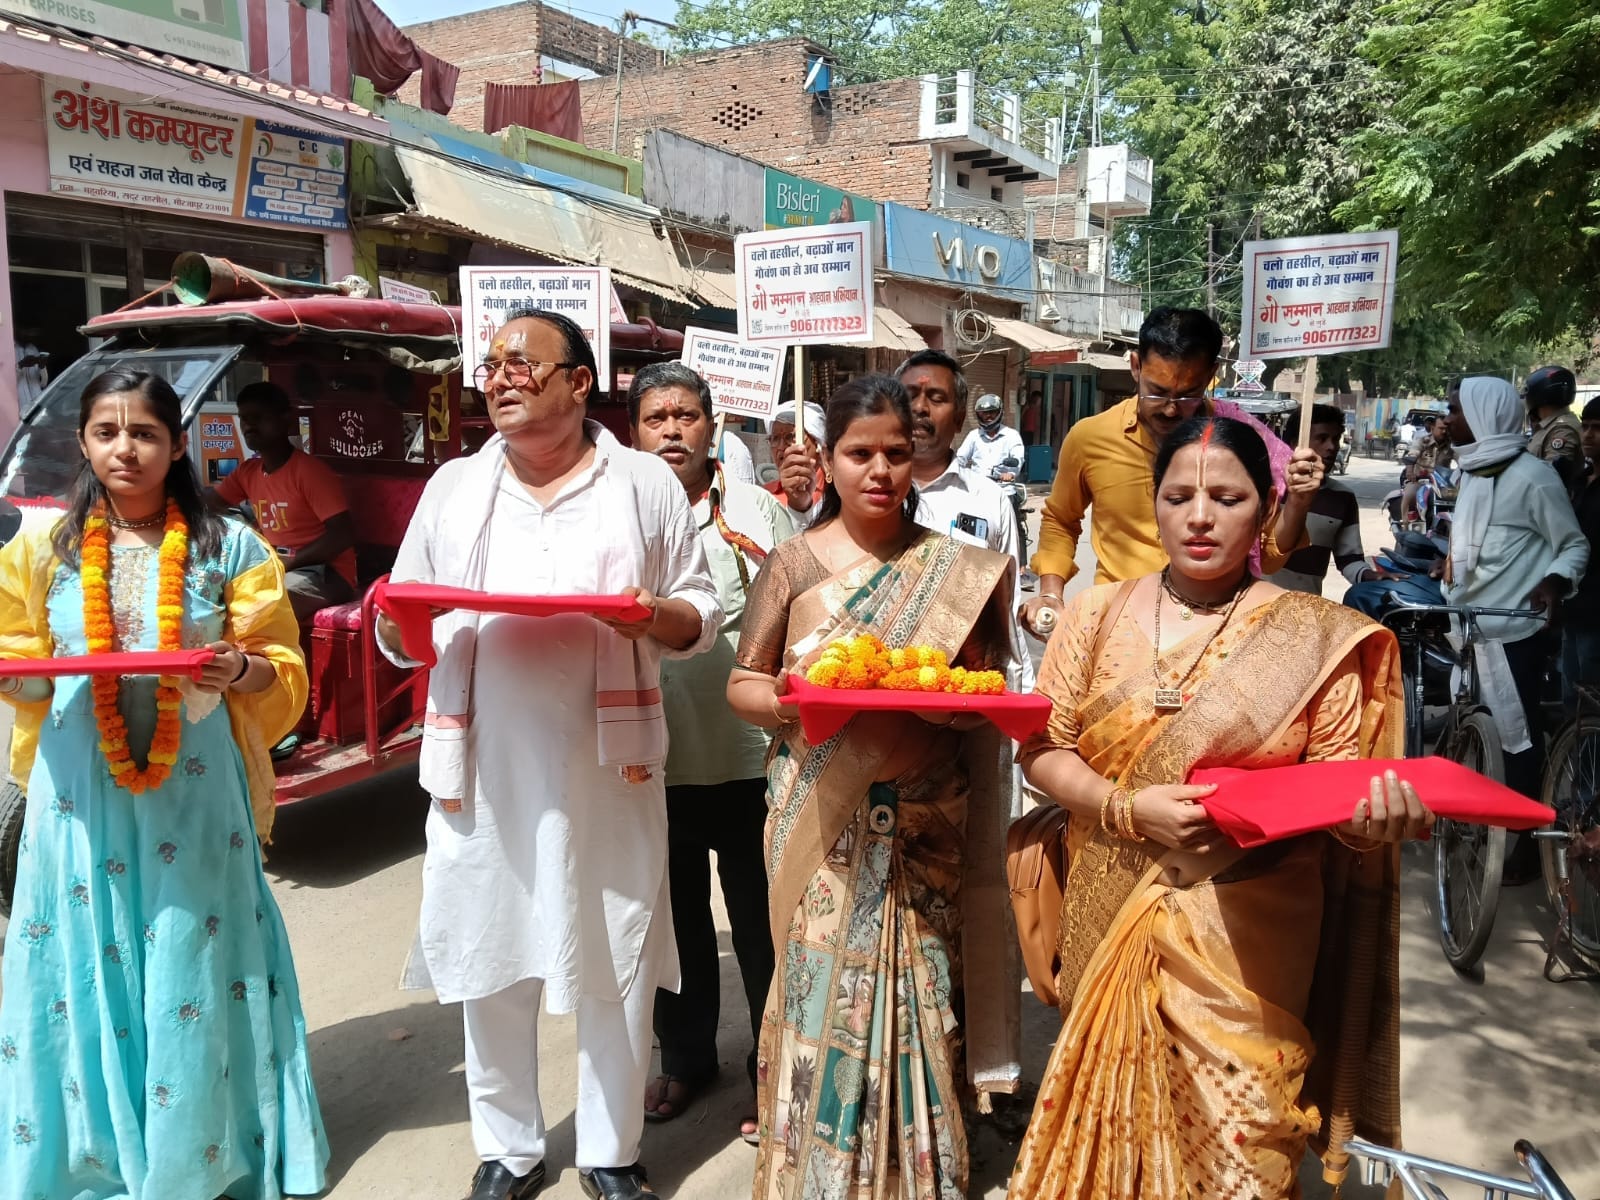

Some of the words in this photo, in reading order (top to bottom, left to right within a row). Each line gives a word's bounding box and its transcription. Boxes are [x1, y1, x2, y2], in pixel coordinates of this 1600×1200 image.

[54, 81, 121, 138] अंश
[125, 109, 235, 162] कम्प्यूटर
[69, 153, 93, 174] एवं
[96, 160, 135, 178] सहज
[138, 166, 164, 182] जन
[167, 167, 194, 186] सेवा
[197, 172, 228, 192] केन्द्र
[777, 183, 820, 212] Bisleri
[752, 247, 768, 261] चलो
[769, 244, 803, 259] तहसील,
[836, 241, 854, 254] मान
[779, 265, 791, 277] का
[793, 262, 802, 276] हो
[803, 263, 819, 275] अब
[821, 260, 851, 273] सम्मान
[1263, 256, 1284, 271] चलो
[1286, 254, 1325, 270] तहसील,
[1361, 251, 1379, 263] मान
[478, 276, 497, 290] चलो
[500, 276, 535, 292] तहसील,
[571, 279, 592, 291] मान
[1296, 276, 1309, 287] का
[1311, 272, 1322, 287] हो
[1323, 273, 1341, 286] अब
[1343, 271, 1374, 284] सम्मान
[509, 299, 522, 309] का
[536, 299, 553, 310] अब
[555, 299, 588, 310] सम्मान
[790, 316, 862, 333] 9067777323
[1302, 326, 1377, 345] 9067777323
[697, 340, 711, 350] चलो
[761, 351, 774, 361] मान
[718, 394, 769, 411] 9067777323
[338, 410, 364, 422] IDEAL
[203, 418, 234, 437] अंश
[329, 436, 384, 458] BULLDOZER
